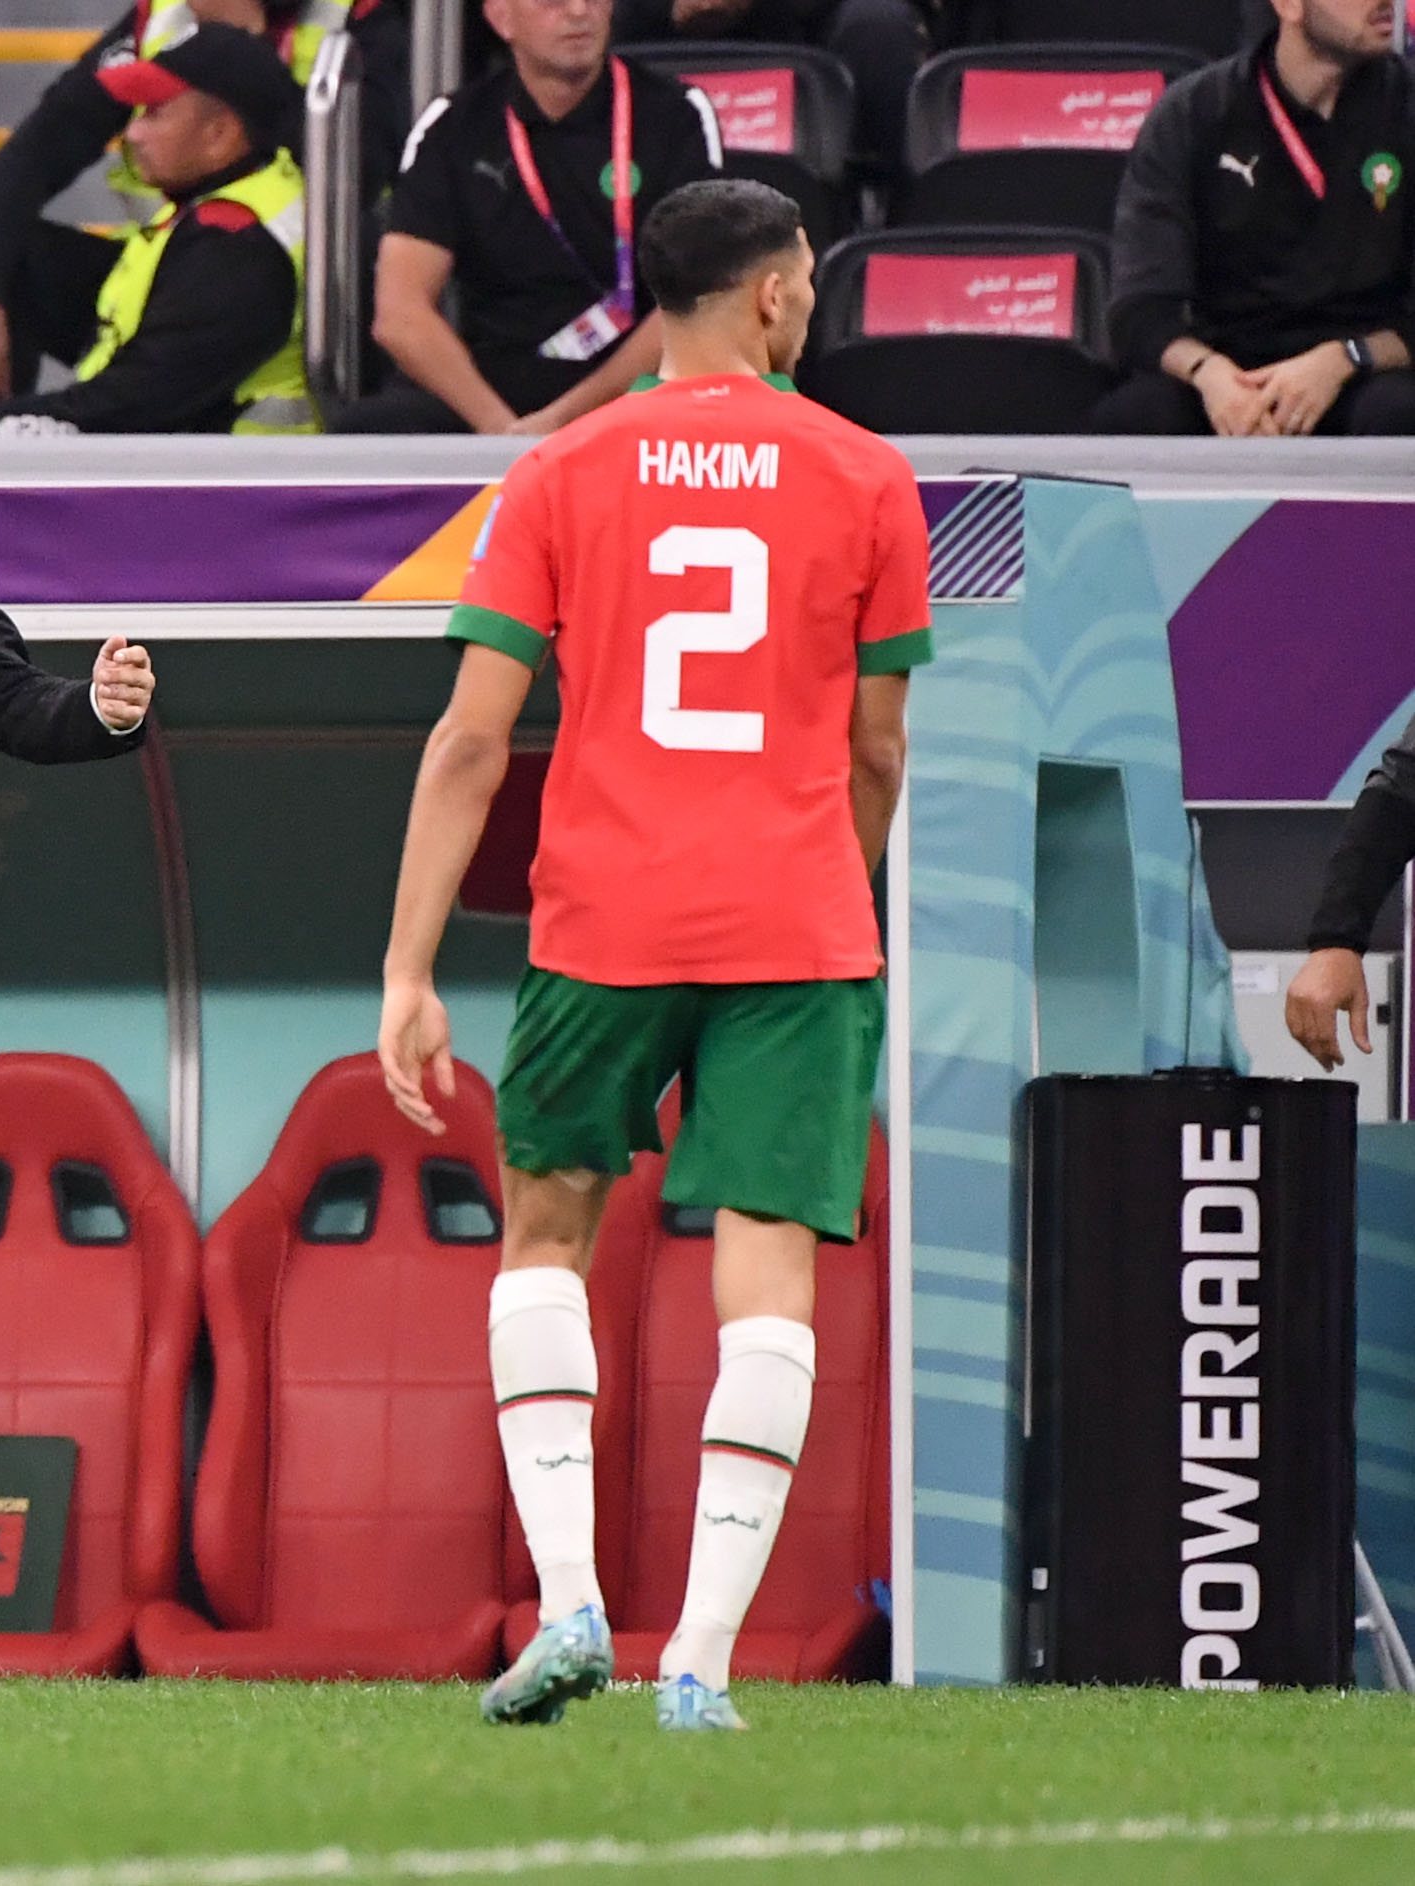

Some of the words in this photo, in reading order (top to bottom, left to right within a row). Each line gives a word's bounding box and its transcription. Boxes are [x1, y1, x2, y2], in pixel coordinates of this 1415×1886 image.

[639, 439, 780, 489] HAKIMI
[641, 525, 769, 752] 2
[1181, 1123, 1261, 1691] POWERADE
